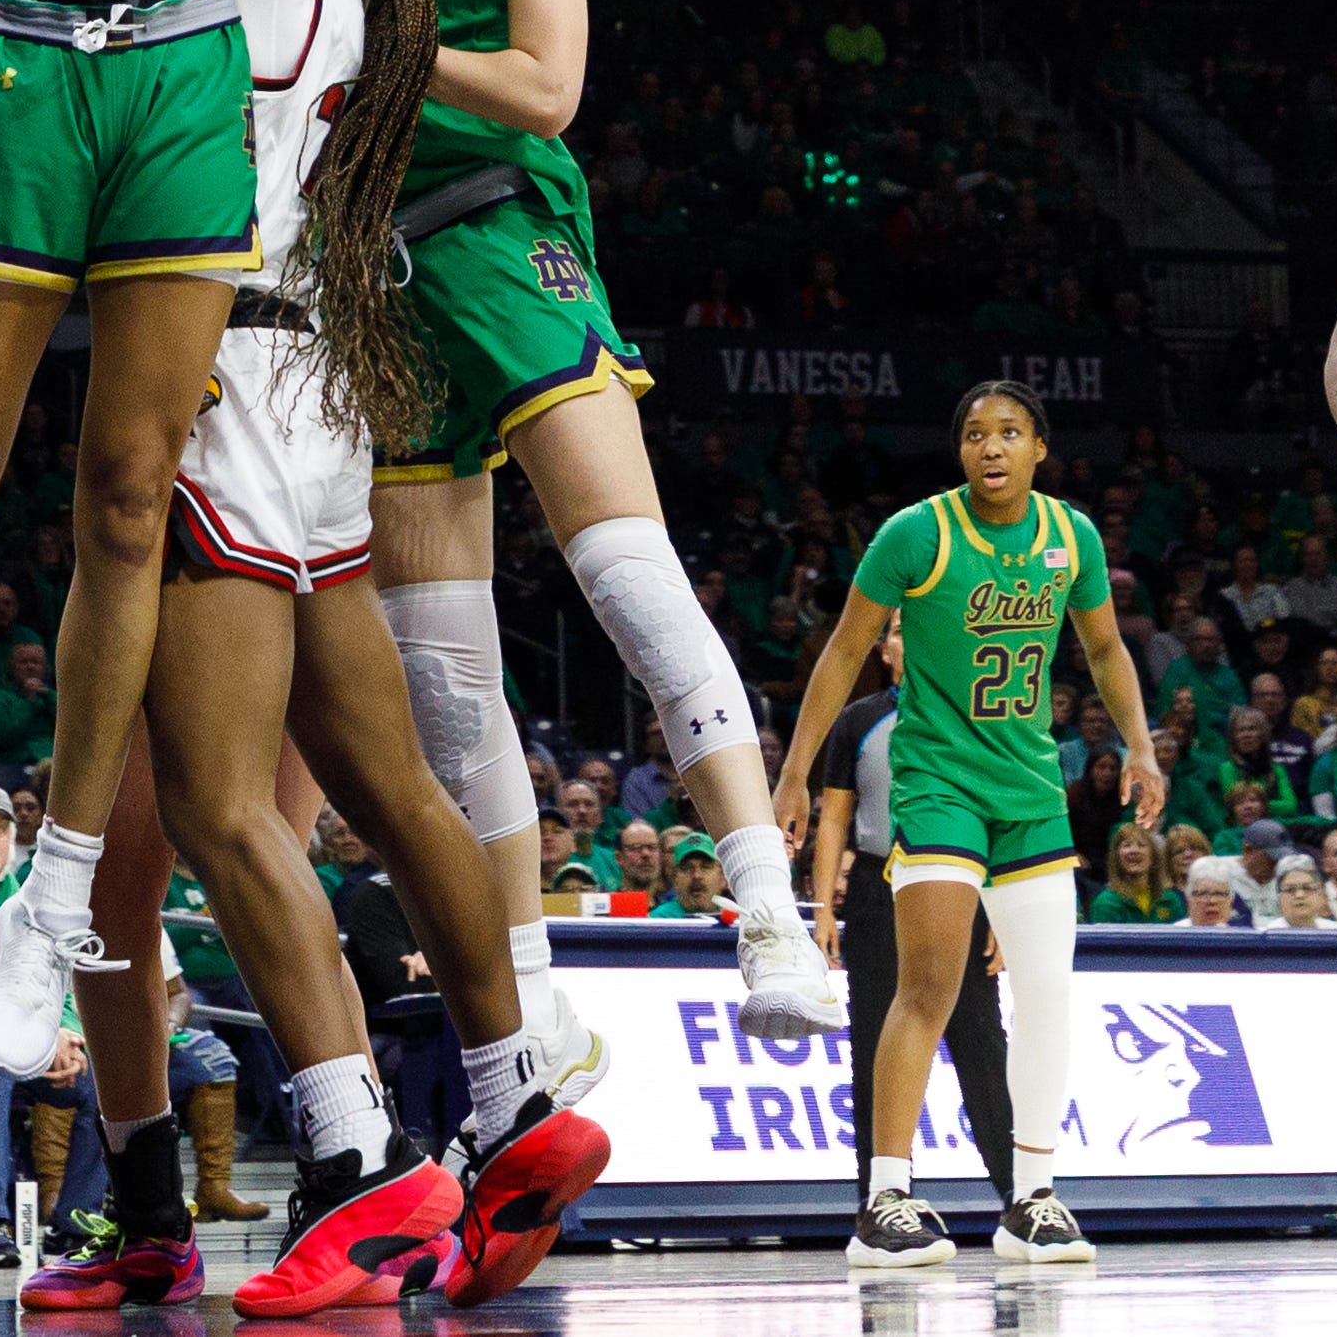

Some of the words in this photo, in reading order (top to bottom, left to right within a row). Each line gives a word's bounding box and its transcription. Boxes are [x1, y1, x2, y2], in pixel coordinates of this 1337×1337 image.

[719, 348, 903, 398] VANESSA
[1000, 353, 1105, 401] LEAH
[966, 580, 1056, 629] Irish
[970, 643, 1047, 720] 23
[21, 1203, 32, 1247] POPCORN
